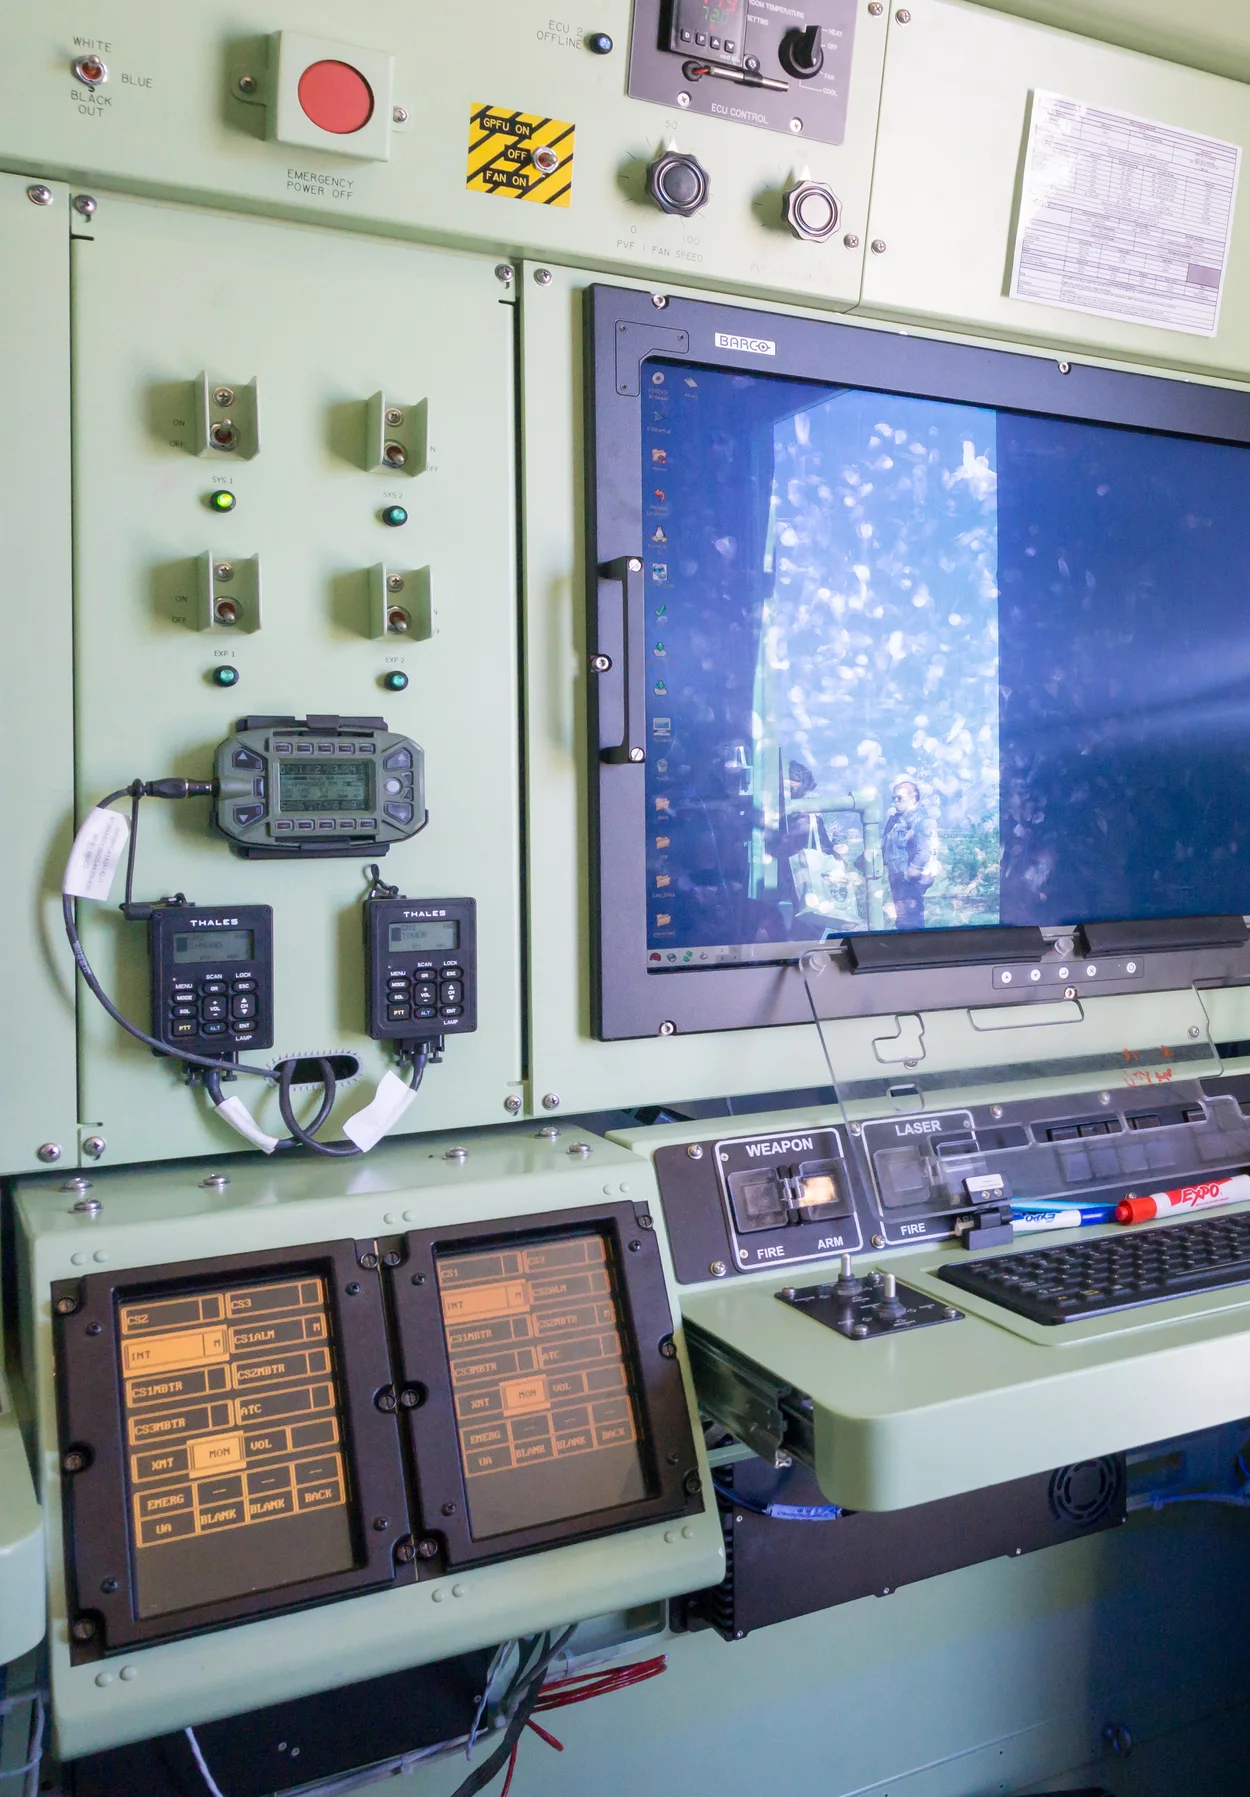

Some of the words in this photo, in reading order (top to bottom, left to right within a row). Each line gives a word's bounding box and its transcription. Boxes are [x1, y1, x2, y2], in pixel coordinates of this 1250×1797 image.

[766, 2, 805, 19] TEMPERATURE
[548, 20, 570, 34] ECU
[576, 27, 583, 37] 2
[829, 28, 843, 37] HEAT
[73, 36, 113, 53] WHITE
[536, 30, 583, 49] OFFLINE
[121, 73, 153, 88] BLUE
[824, 72, 835, 81] FAN
[70, 89, 112, 106] BLACK
[822, 87, 838, 97] COOL
[78, 104, 104, 117] OUT
[711, 103, 728, 115] ECU
[730, 107, 768, 124] CONTROL
[483, 118, 510, 131] GPFU
[515, 124, 530, 136] ON
[665, 120, 678, 130] 50
[507, 149, 528, 161] OFF
[287, 168, 354, 189] EMERGENCY
[485, 171, 507, 183] FAN
[512, 175, 527, 187] ON
[286, 181, 325, 195] POWER
[332, 189, 353, 200] OFF
[683, 235, 700, 245] 100
[616, 240, 634, 250] PVF
[652, 246, 670, 257] FAN
[676, 250, 704, 263] SPEED
[720, 335, 771, 353] BARCO
[169, 440, 183, 448] OFF
[214, 649, 229, 657] EXP
[190, 918, 239, 927] THALES
[895, 1120, 942, 1137] LASER
[745, 1138, 814, 1158] WEAPON
[1181, 1183, 1220, 1207] EXPO
[1025, 1212, 1055, 1223] EXPO
[901, 1223, 926, 1236] FIRE
[818, 1237, 844, 1250] ARM
[757, 1246, 785, 1260] FIRE
[441, 1269, 459, 1278] CS1
[231, 1299, 252, 1310] CS3
[127, 1314, 149, 1326] CS2
[234, 1330, 275, 1345] CS1ALM
[312, 1322, 320, 1332] M
[450, 1330, 492, 1344] CS1MBTR
[131, 1350, 151, 1361] INT
[214, 1339, 221, 1347] M
[237, 1364, 285, 1380] CS2MBTR
[132, 1381, 183, 1398] CS1MBTR
[518, 1389, 536, 1399] MON
[552, 1383, 571, 1392] VOL
[240, 1404, 262, 1416] ATC
[470, 1397, 490, 1409] XMT
[134, 1419, 185, 1435] CS3MBTR
[602, 1427, 625, 1440] BACK
[250, 1439, 272, 1450] VOL
[470, 1431, 501, 1445] EMERG
[555, 1436, 586, 1450] BLANK
[209, 1447, 230, 1459] MON
[515, 1444, 545, 1458] BLANK
[151, 1457, 174, 1471] XMT
[147, 1494, 185, 1510] EMERG
[305, 1489, 332, 1503] BACK
[250, 1499, 285, 1515] BLANK
[200, 1510, 236, 1525] BLANK
[156, 1524, 172, 1535] UA
